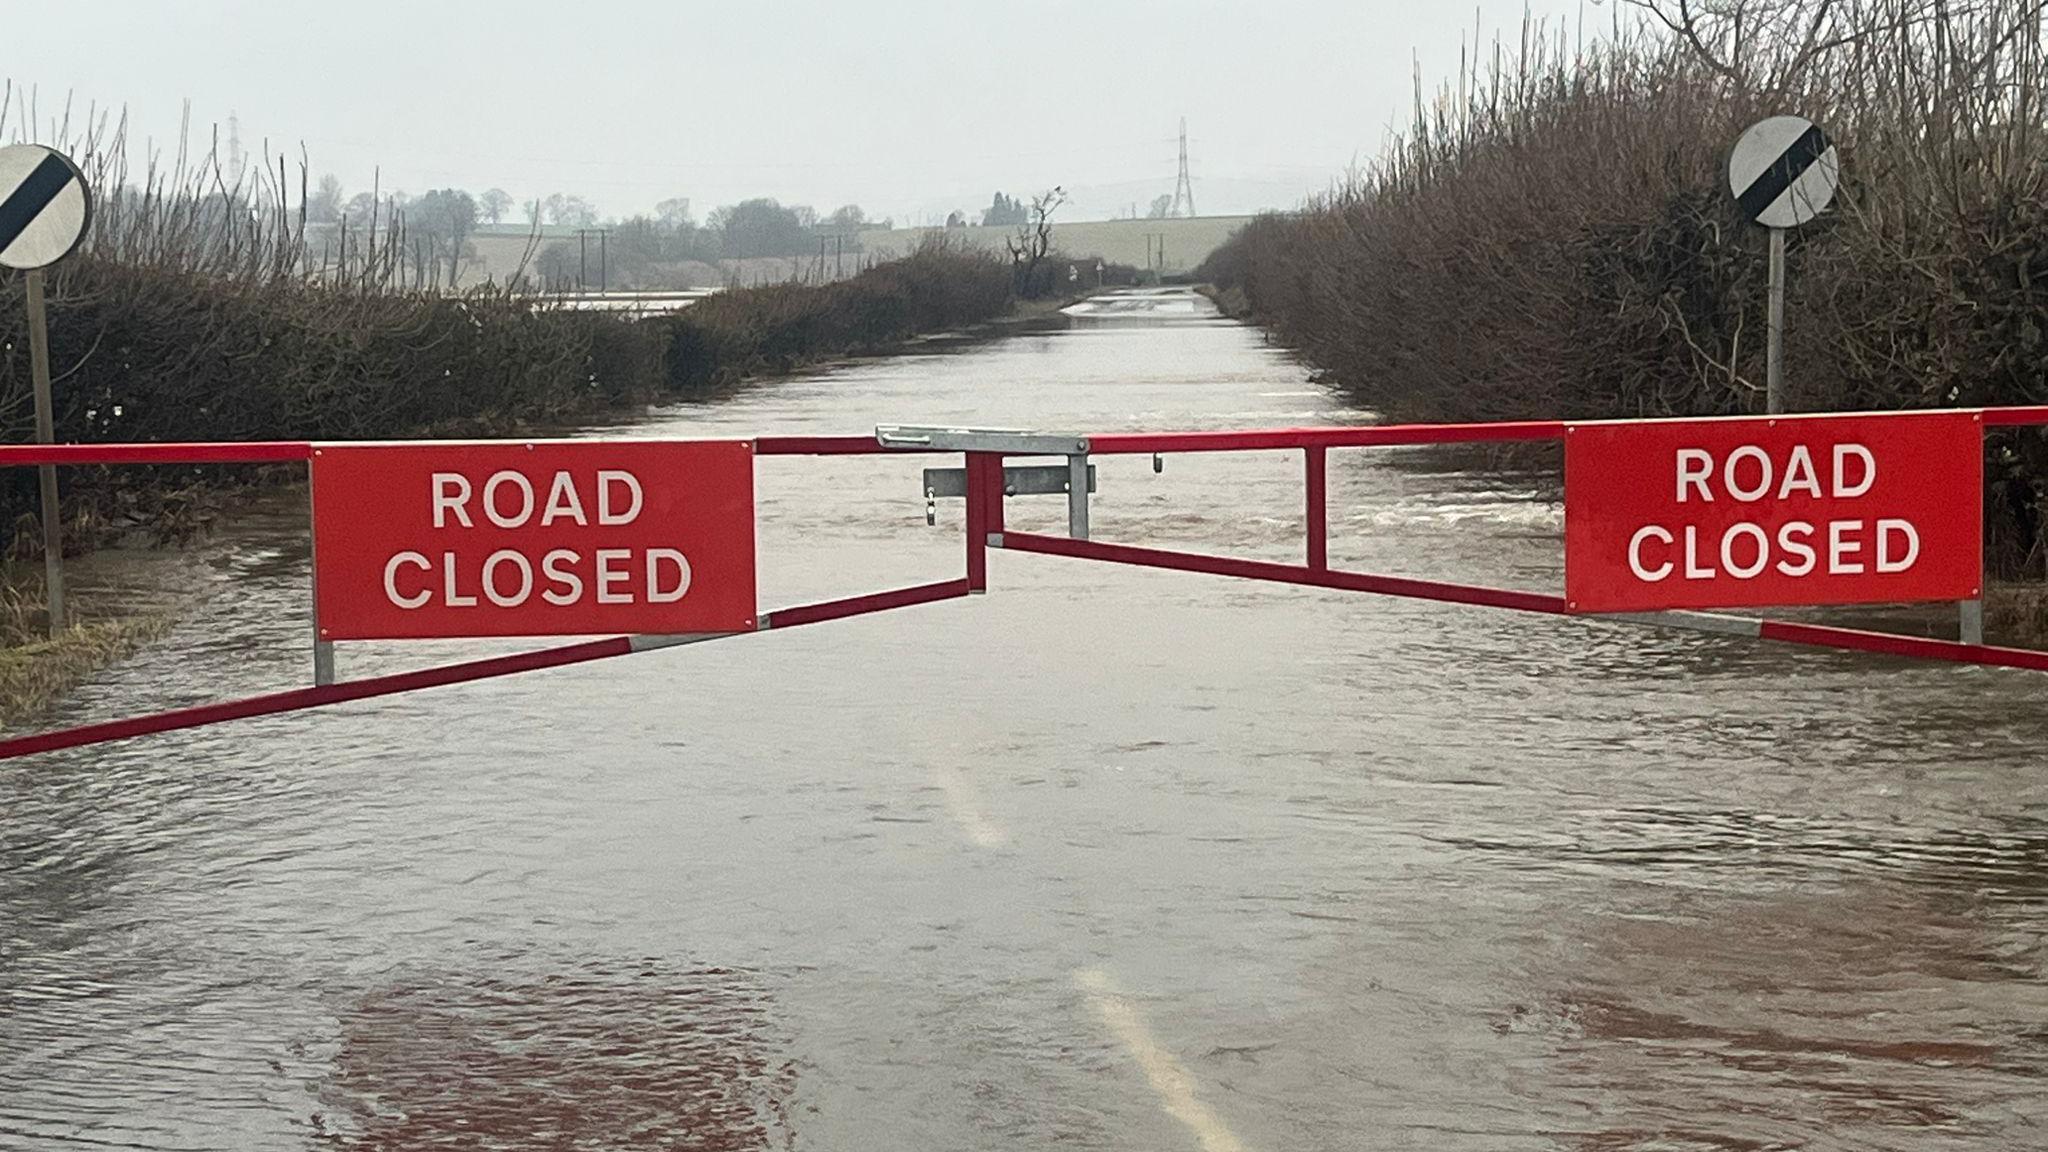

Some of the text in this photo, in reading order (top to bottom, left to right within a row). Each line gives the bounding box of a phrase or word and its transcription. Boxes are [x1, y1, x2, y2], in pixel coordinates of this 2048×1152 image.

[431, 470, 643, 528] ROAD
[1676, 443, 1876, 502] ROAD
[384, 548, 691, 609] CLOSED
[1628, 518, 1920, 582] CLOSED
